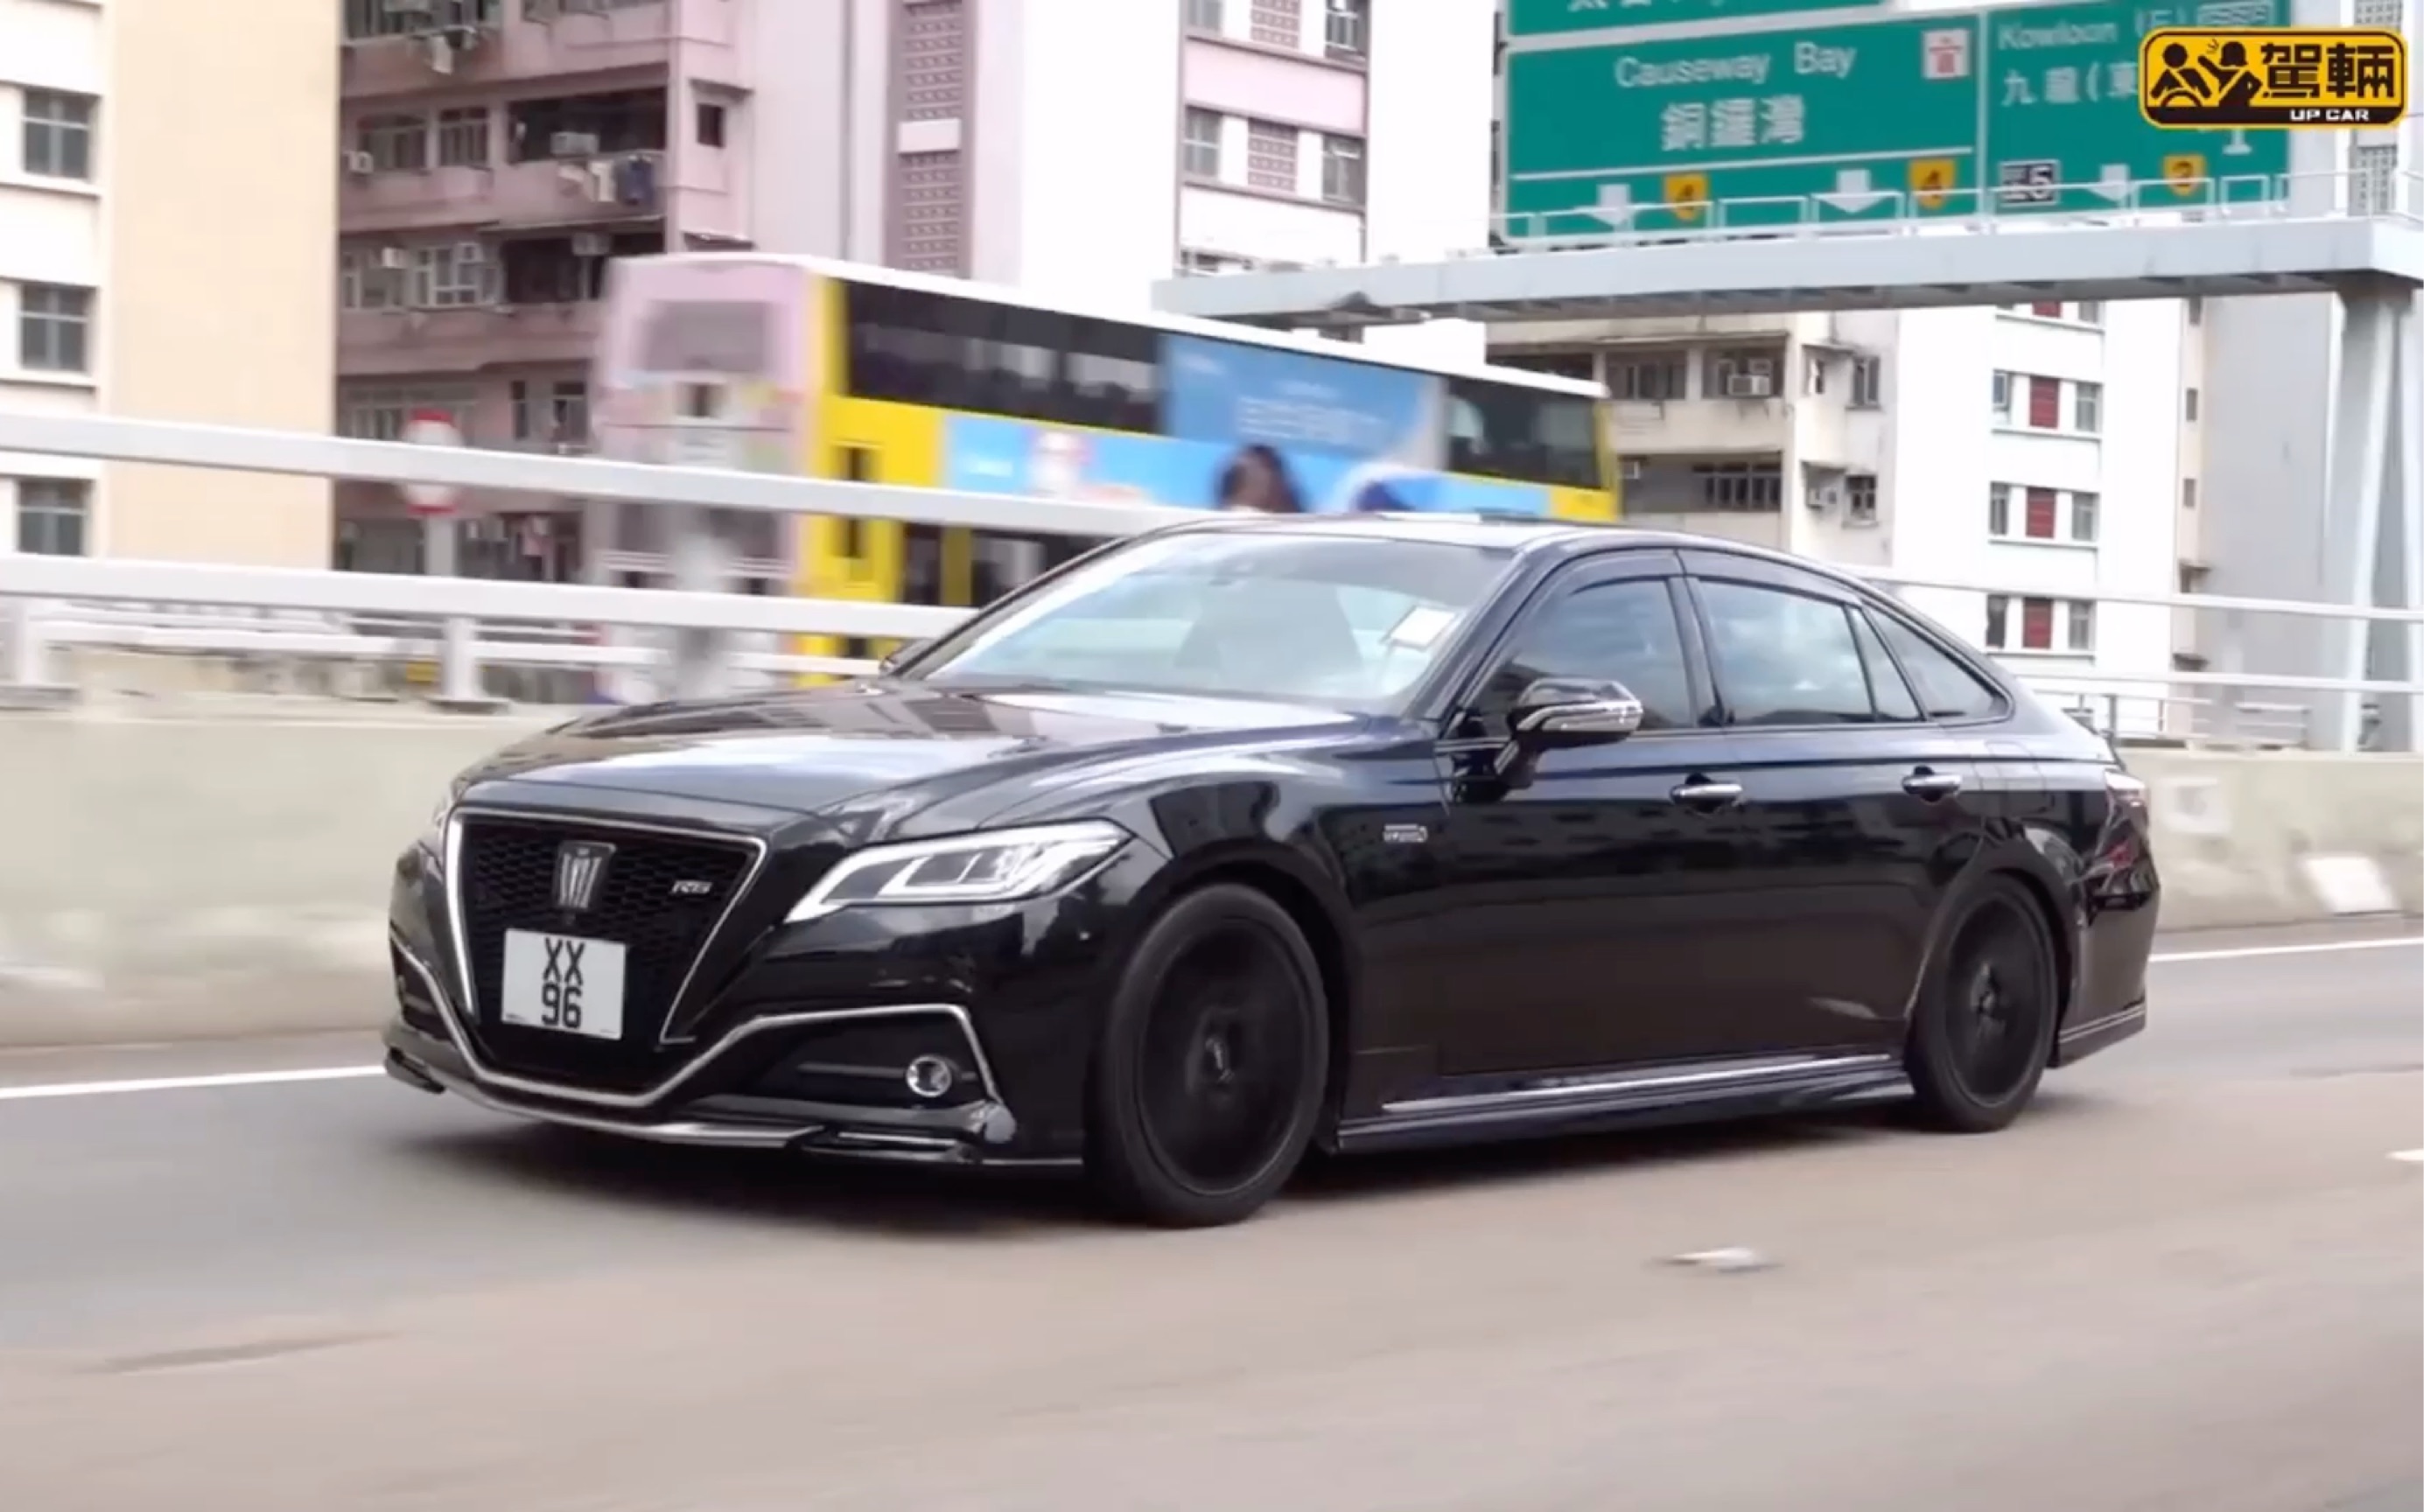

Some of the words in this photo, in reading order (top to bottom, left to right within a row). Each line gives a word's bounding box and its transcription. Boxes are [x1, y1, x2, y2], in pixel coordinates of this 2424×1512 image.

[1615, 54, 1771, 88] Causeway
[1794, 40, 1857, 79] Bay
[1660, 93, 1805, 151] 銅鑼灣
[671, 879, 713, 894] RS
[543, 936, 585, 987] XX
[541, 981, 583, 1029] 96
